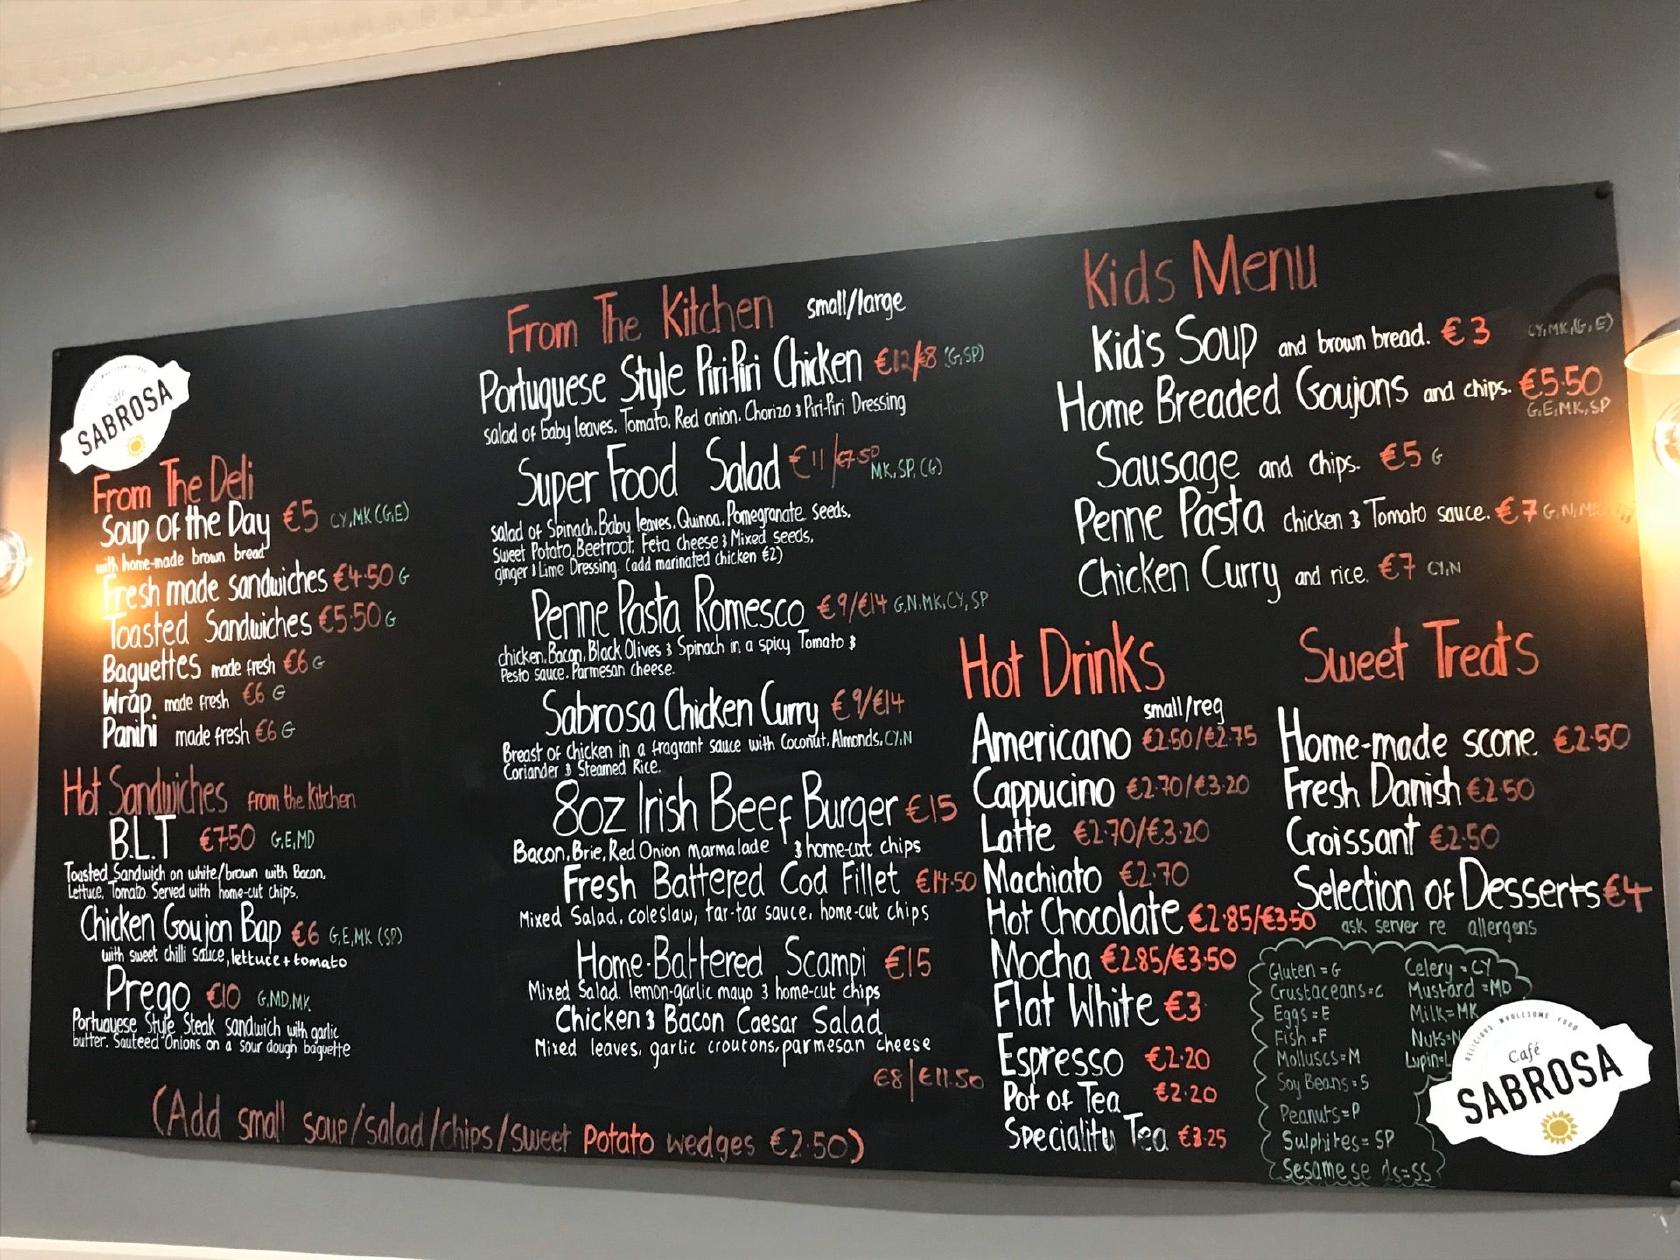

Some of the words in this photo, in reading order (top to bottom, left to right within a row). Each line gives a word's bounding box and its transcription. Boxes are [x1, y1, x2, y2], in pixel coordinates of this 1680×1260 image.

[1085, 249, 1174, 309] Kids
[1193, 234, 1317, 299] Menu
[507, 304, 577, 354] From
[593, 292, 641, 344] The
[663, 284, 773, 339] Kitchen
[807, 288, 906, 320] small/large
[1092, 324, 1165, 373] Kid's
[1175, 314, 1257, 369] Soup
[1278, 334, 1307, 357] and
[1317, 328, 1366, 354] brown
[480, 367, 606, 422] Portuguese
[620, 351, 686, 413] Style
[774, 335, 862, 388] Chicken
[1057, 380, 1143, 432] Home
[1157, 372, 1281, 424] Breaded
[1296, 365, 1409, 419] Goujons
[1424, 381, 1455, 403] and
[77, 379, 173, 456] SABROSA
[745, 400, 791, 421] Chorizo
[852, 391, 906, 416] Dressing
[94, 474, 151, 514] From
[159, 457, 202, 507] The
[210, 453, 253, 505] Deli
[517, 457, 599, 526] Super
[607, 441, 678, 502] Food
[706, 436, 781, 493] Salad
[1096, 441, 1240, 497] Sausage
[1259, 455, 1293, 479] and
[100, 513, 150, 556] Soup
[185, 505, 221, 540] the
[228, 498, 270, 553] Day
[727, 500, 807, 530] Pomegranate
[1075, 497, 1164, 544] Penne
[1180, 482, 1265, 538] Pasta
[1284, 505, 1343, 532] chicken
[1363, 496, 1426, 528] Tomato
[234, 540, 269, 561] bread
[102, 574, 160, 611] Fresh
[171, 571, 219, 605] made
[228, 559, 328, 601] sandwiches
[1078, 551, 1189, 597] Chicken
[1202, 545, 1281, 604] Curry
[1295, 565, 1321, 585] and
[104, 611, 189, 647] Toasted
[205, 607, 312, 642] Sandwiches
[532, 588, 610, 640] Penne
[618, 579, 681, 635] Pasta
[695, 574, 808, 635] Romesco
[588, 638, 622, 662] Black
[677, 634, 724, 661] Spinach
[797, 629, 844, 649] Tomato
[960, 634, 1024, 699] Hot
[1040, 620, 1165, 697] Drinks
[1299, 626, 1408, 683] Sweet
[1422, 619, 1539, 679] Treats
[103, 648, 201, 695] Baguettes
[211, 658, 241, 678] made
[247, 653, 276, 676] fresh
[103, 712, 157, 749] Panini
[543, 689, 656, 736] Sabrosa
[664, 686, 752, 731] Chicken
[761, 680, 823, 740] Curry
[1144, 695, 1225, 727] small/reg
[652, 736, 703, 760] fragrant
[972, 712, 1131, 764] Americano
[1278, 706, 1447, 767] Home-made
[64, 767, 101, 816] Hot
[109, 764, 227, 818] Sandwiches
[248, 791, 280, 811] from
[284, 784, 305, 809] the
[308, 781, 356, 810] Kitchen
[553, 779, 626, 836] 8oz
[639, 776, 698, 834] Irish
[711, 771, 793, 848] Beef
[802, 770, 899, 847] Burger
[973, 766, 1115, 819] Cappucino
[1284, 766, 1360, 810] Fresh
[1371, 761, 1461, 808] Danish
[981, 811, 1055, 853] Latte
[1286, 813, 1421, 856] Croissant
[64, 861, 108, 885] Toasted
[110, 862, 165, 884] Sandwich
[564, 864, 637, 904] Fresh
[654, 860, 765, 900] Battered
[781, 860, 828, 896] Cod
[843, 860, 900, 896] Fillet
[983, 856, 1102, 894] Machiato
[1294, 865, 1414, 914] Selection
[1425, 878, 1455, 910] of
[1459, 857, 1600, 911] Desserts
[81, 904, 155, 941] Chicken
[163, 902, 232, 945] Goujon
[241, 900, 281, 956] Bap
[520, 905, 562, 928] Mixed
[987, 897, 1033, 935] Hot
[1041, 887, 1183, 935] Chocolate
[1375, 919, 1419, 934] server
[1468, 917, 1537, 943] allergens
[164, 944, 186, 963] chilli
[785, 935, 866, 991] Scampi
[991, 938, 1092, 980] Mocha
[1269, 963, 1316, 980] Gluten
[1405, 958, 1452, 987] Celery
[104, 964, 193, 1025] Prego
[994, 979, 1055, 1027] Flat
[1068, 983, 1159, 1028] White
[1409, 979, 1474, 999] Mustard
[225, 1015, 281, 1037] sandwich
[311, 1022, 339, 1043] garlic
[556, 1004, 640, 1033] Chicken
[664, 1004, 724, 1034] Bacon
[737, 1005, 798, 1034] Caesar
[813, 1005, 883, 1035] Salad
[304, 1035, 351, 1061] baguette
[650, 1039, 696, 1069] garlic
[782, 1038, 864, 1067] parmesan
[876, 1034, 931, 1053] cheese
[998, 1032, 1124, 1087] Espresso
[1004, 1079, 1040, 1112] Pot
[1077, 1081, 1121, 1114] Tea
[1457, 1043, 1623, 1125] SABROSA
[584, 1122, 654, 1154] Potato
[667, 1126, 754, 1157] wedges
